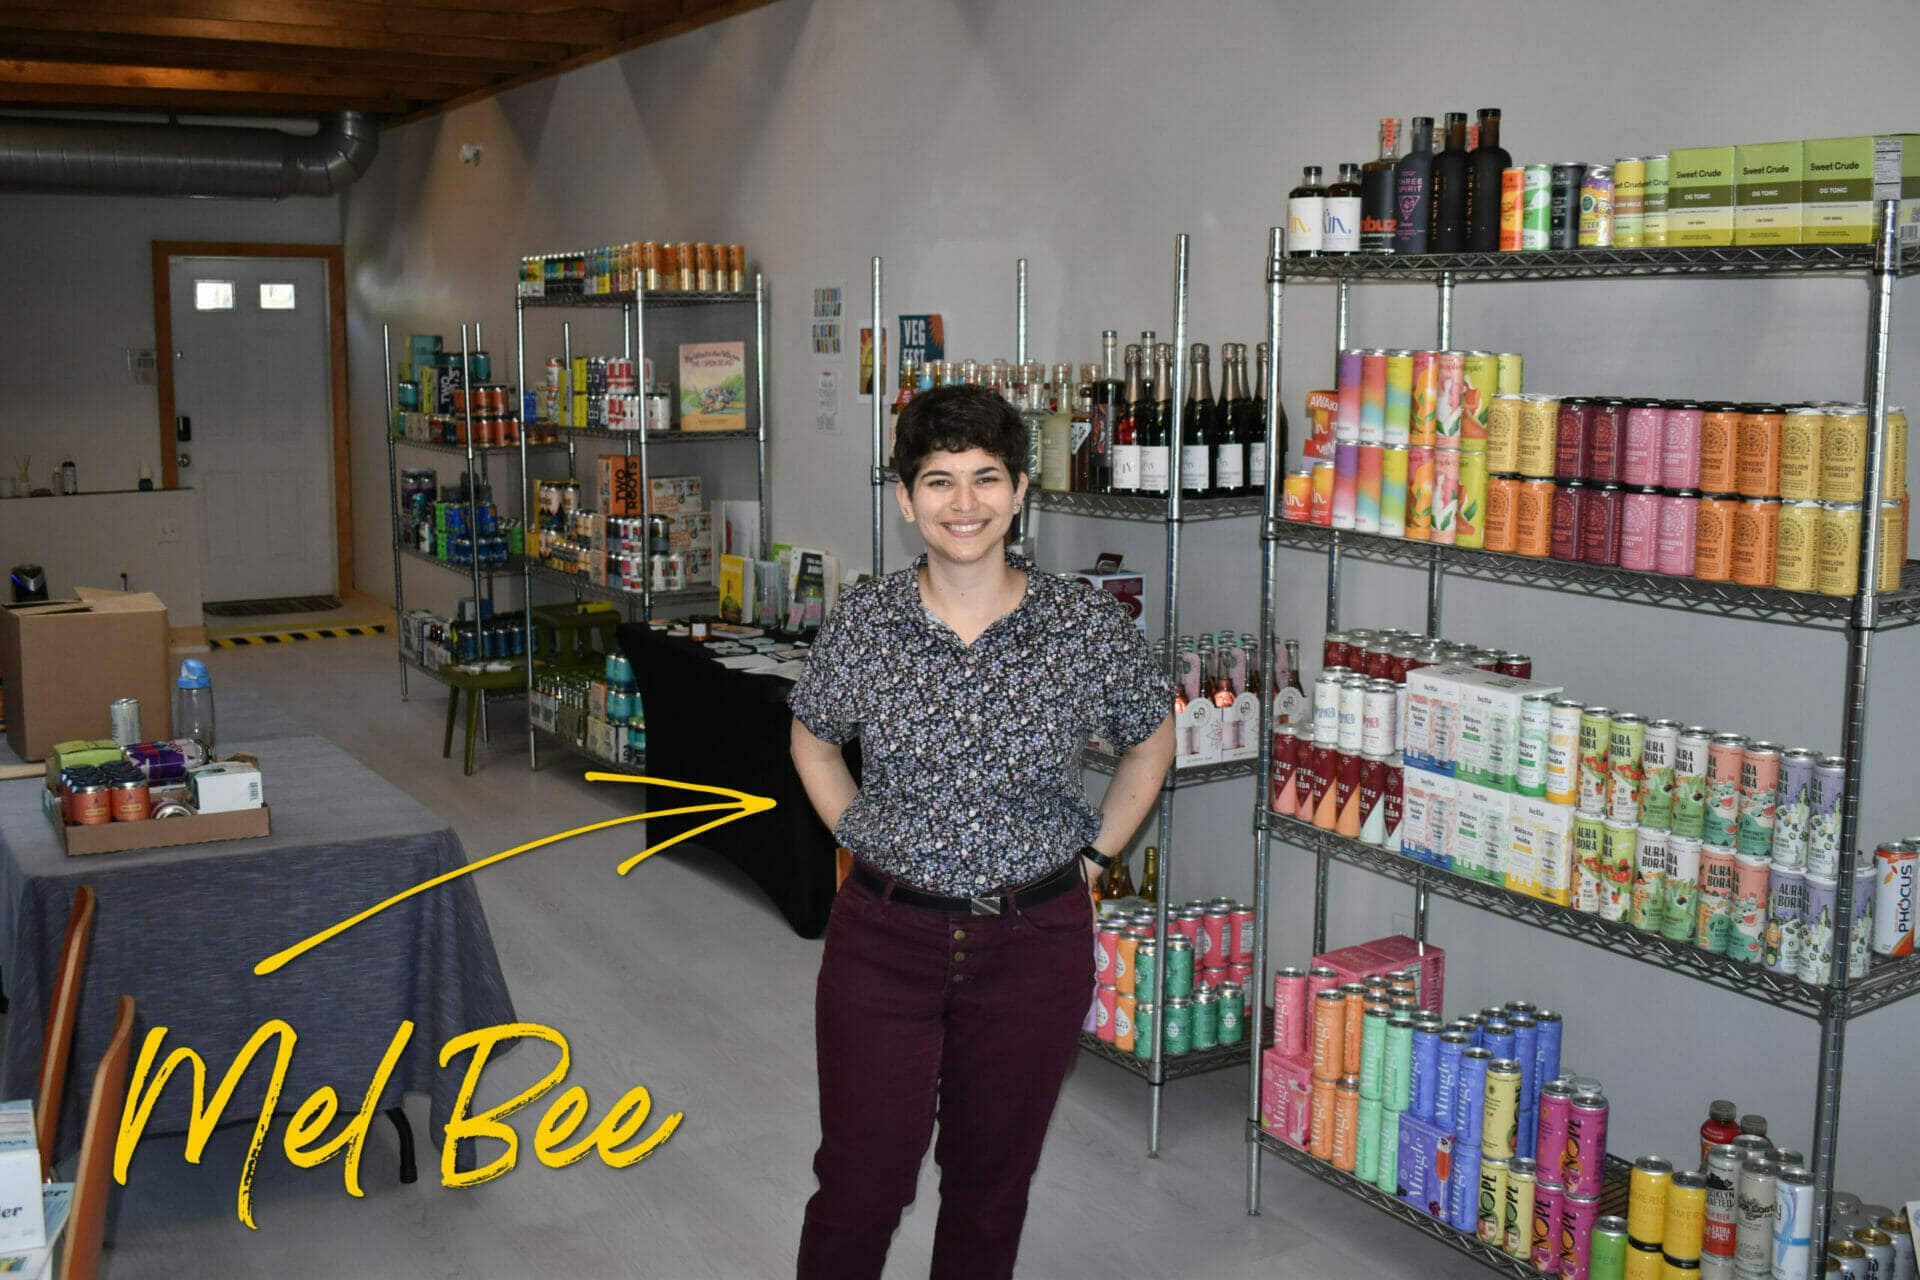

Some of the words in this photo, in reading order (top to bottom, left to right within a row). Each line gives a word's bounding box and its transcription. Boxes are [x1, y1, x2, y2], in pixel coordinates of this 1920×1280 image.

[1676, 170, 1697, 179] Sweet
[1698, 168, 1722, 178] Crude
[1743, 166, 1765, 175] Sweet
[1765, 165, 1789, 174] Crude
[1810, 162, 1833, 171] Sweet
[1834, 161, 1860, 170] Crude
[903, 320, 926, 346] VEG
[440, 376, 451, 404] TWO
[615, 469, 626, 502] TWO
[626, 462, 638, 510] ROOTS
[1641, 856, 1665, 869] BORA
[1643, 845, 1665, 857] AURA
[1707, 875, 1731, 889] BORA
[1708, 863, 1731, 876] AURA
[1778, 895, 1801, 909] BORA
[1779, 883, 1801, 896] AURA
[1898, 864, 1913, 932] PHOCUS
[1435, 1057, 1455, 1117] Mingle
[1273, 1074, 1290, 1128] Mingle
[1564, 1119, 1582, 1169] NOPE
[1408, 1137, 1430, 1196] Mingle
[1479, 1175, 1497, 1217] NOPE
[1533, 1200, 1551, 1248] NOPE
[1560, 1211, 1577, 1260] NOPE
[1712, 1225, 1731, 1233] EXTRA
[1712, 1232, 1730, 1240] SPICY
